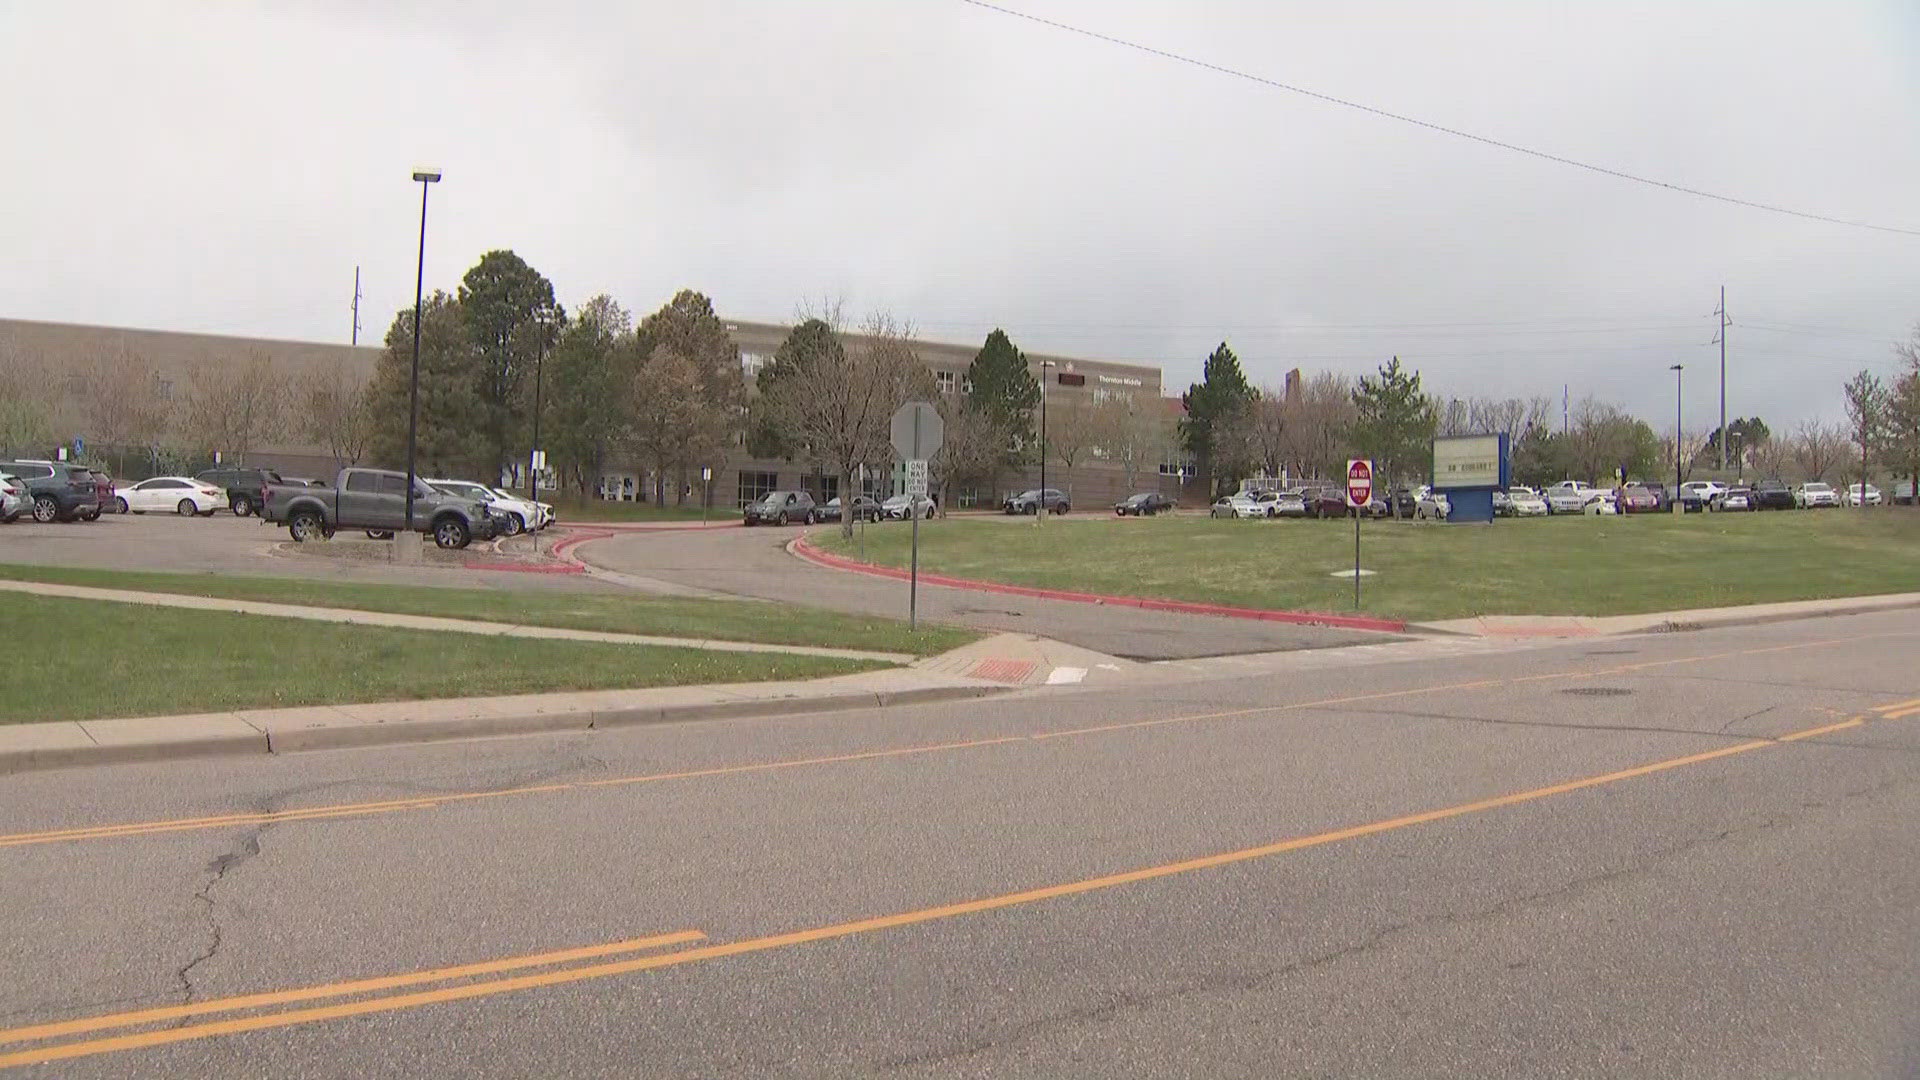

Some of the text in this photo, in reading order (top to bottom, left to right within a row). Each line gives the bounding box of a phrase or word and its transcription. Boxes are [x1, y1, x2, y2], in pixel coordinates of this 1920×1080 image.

[1099, 375, 1141, 386] Thornton Middle
[1351, 469, 1368, 477] DO NOT
[1352, 489, 1366, 497] ENTER
